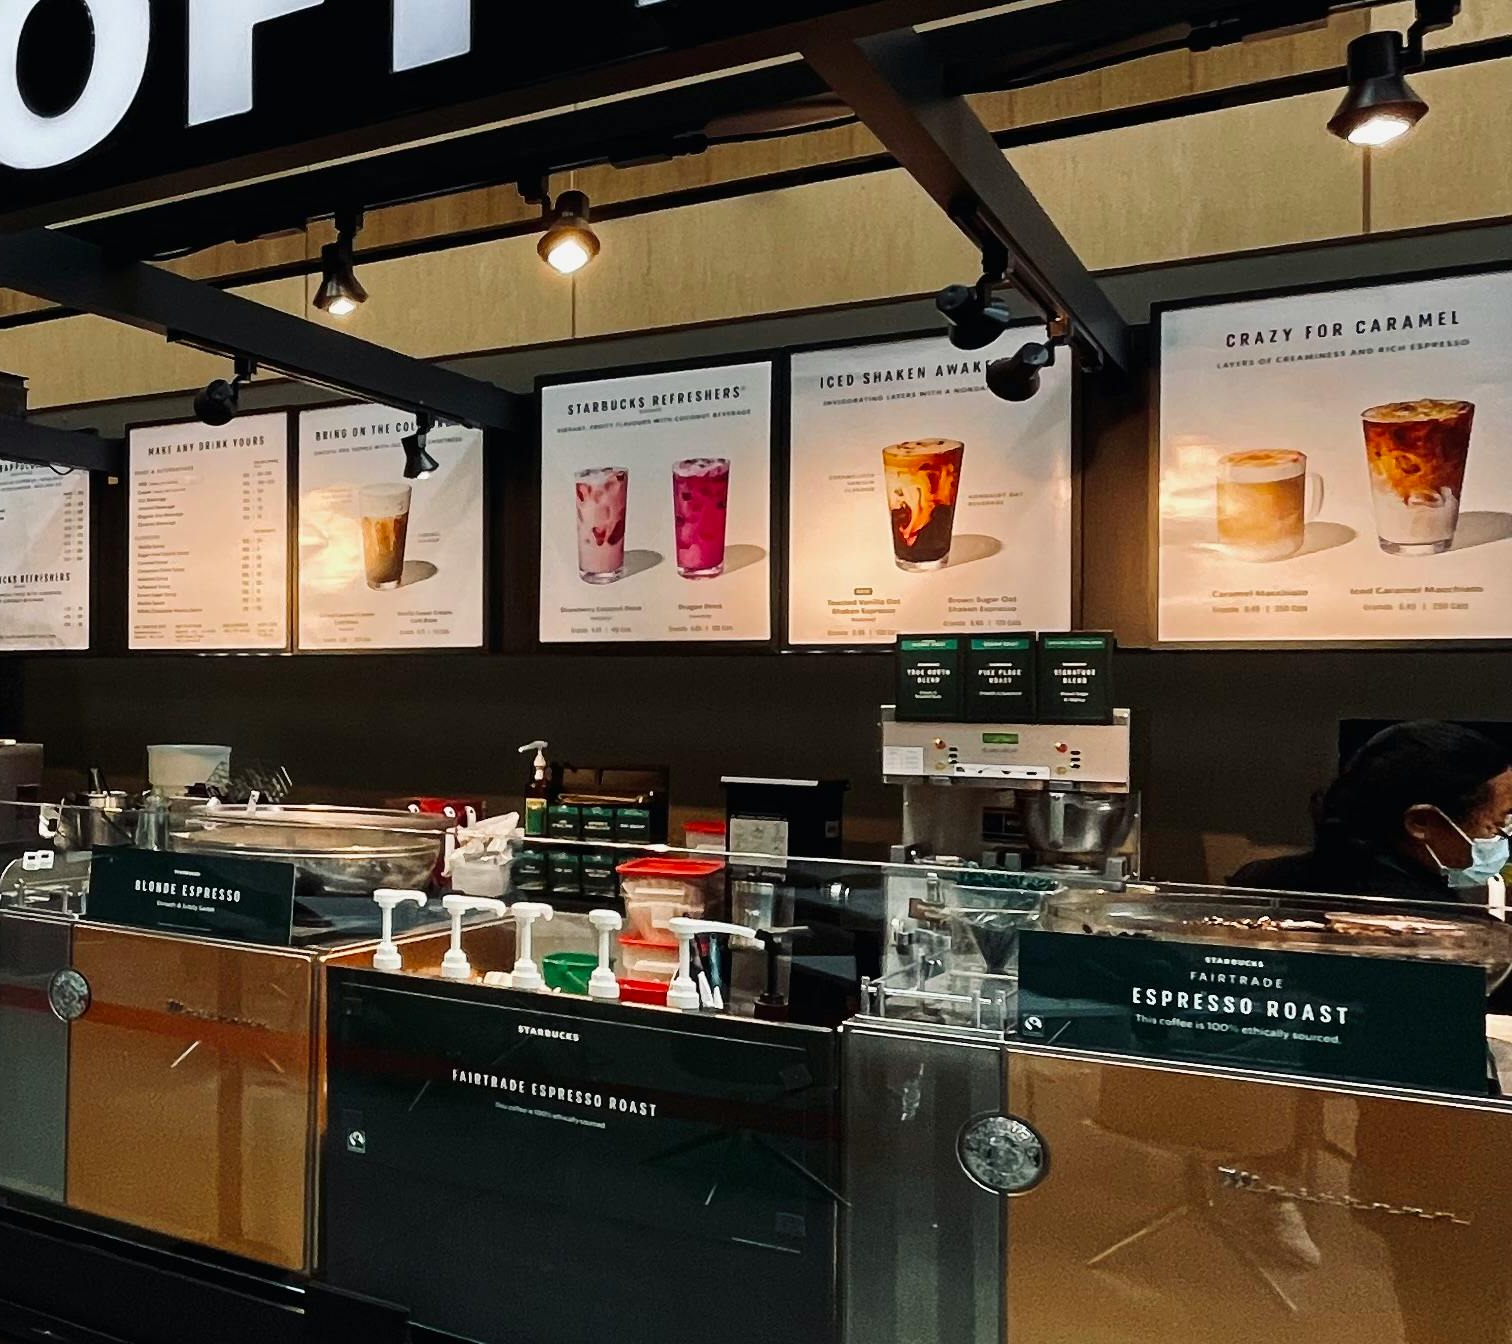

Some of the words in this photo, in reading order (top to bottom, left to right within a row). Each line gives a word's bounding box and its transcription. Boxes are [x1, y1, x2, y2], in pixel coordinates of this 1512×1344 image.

[1226, 328, 1292, 348] CRAZY
[1305, 322, 1343, 339] FOR
[1355, 311, 1460, 335] CARAMEL
[1216, 359, 1255, 369] LAYERS
[1258, 357, 1272, 366] OF
[1276, 350, 1346, 364] CREAMINESS
[1350, 347, 1374, 357] AND
[1378, 344, 1406, 354] RICH
[1410, 339, 1470, 352] ESPRESSO
[820, 375, 855, 390] ICED
[862, 366, 926, 385] SHAKEN
[935, 359, 991, 377] AWAK
[567, 395, 645, 416] STARBUCKS
[316, 429, 347, 441] BRING
[352, 426, 366, 437] ON
[371, 424, 389, 435] THE
[395, 421, 416, 433] COL
[148, 444, 171, 456] MAKE
[176, 442, 194, 453] ANY
[199, 439, 228, 451] DRINK
[232, 435, 265, 448] YOURS
[134, 879, 177, 895] BLONDE
[182, 884, 241, 903] ESPRESSO
[1205, 956, 1264, 968] STARBUCKS
[1190, 971, 1284, 989] FAIRTRADE
[1132, 987, 1252, 1015] ESPRESSO
[1266, 1000, 1349, 1025] ROAST
[518, 1025, 580, 1042] STARBUCKS
[1135, 1013, 1157, 1025] This
[1159, 1017, 1193, 1029] coffee
[1195, 1020, 1205, 1030] is
[1207, 1022, 1238, 1033] 100%
[1241, 1025, 1289, 1040] ethically
[452, 1068, 525, 1094] FAIRTRADE
[531, 1083, 602, 1108] ESPRESSO
[608, 1096, 657, 1117] ROAST
